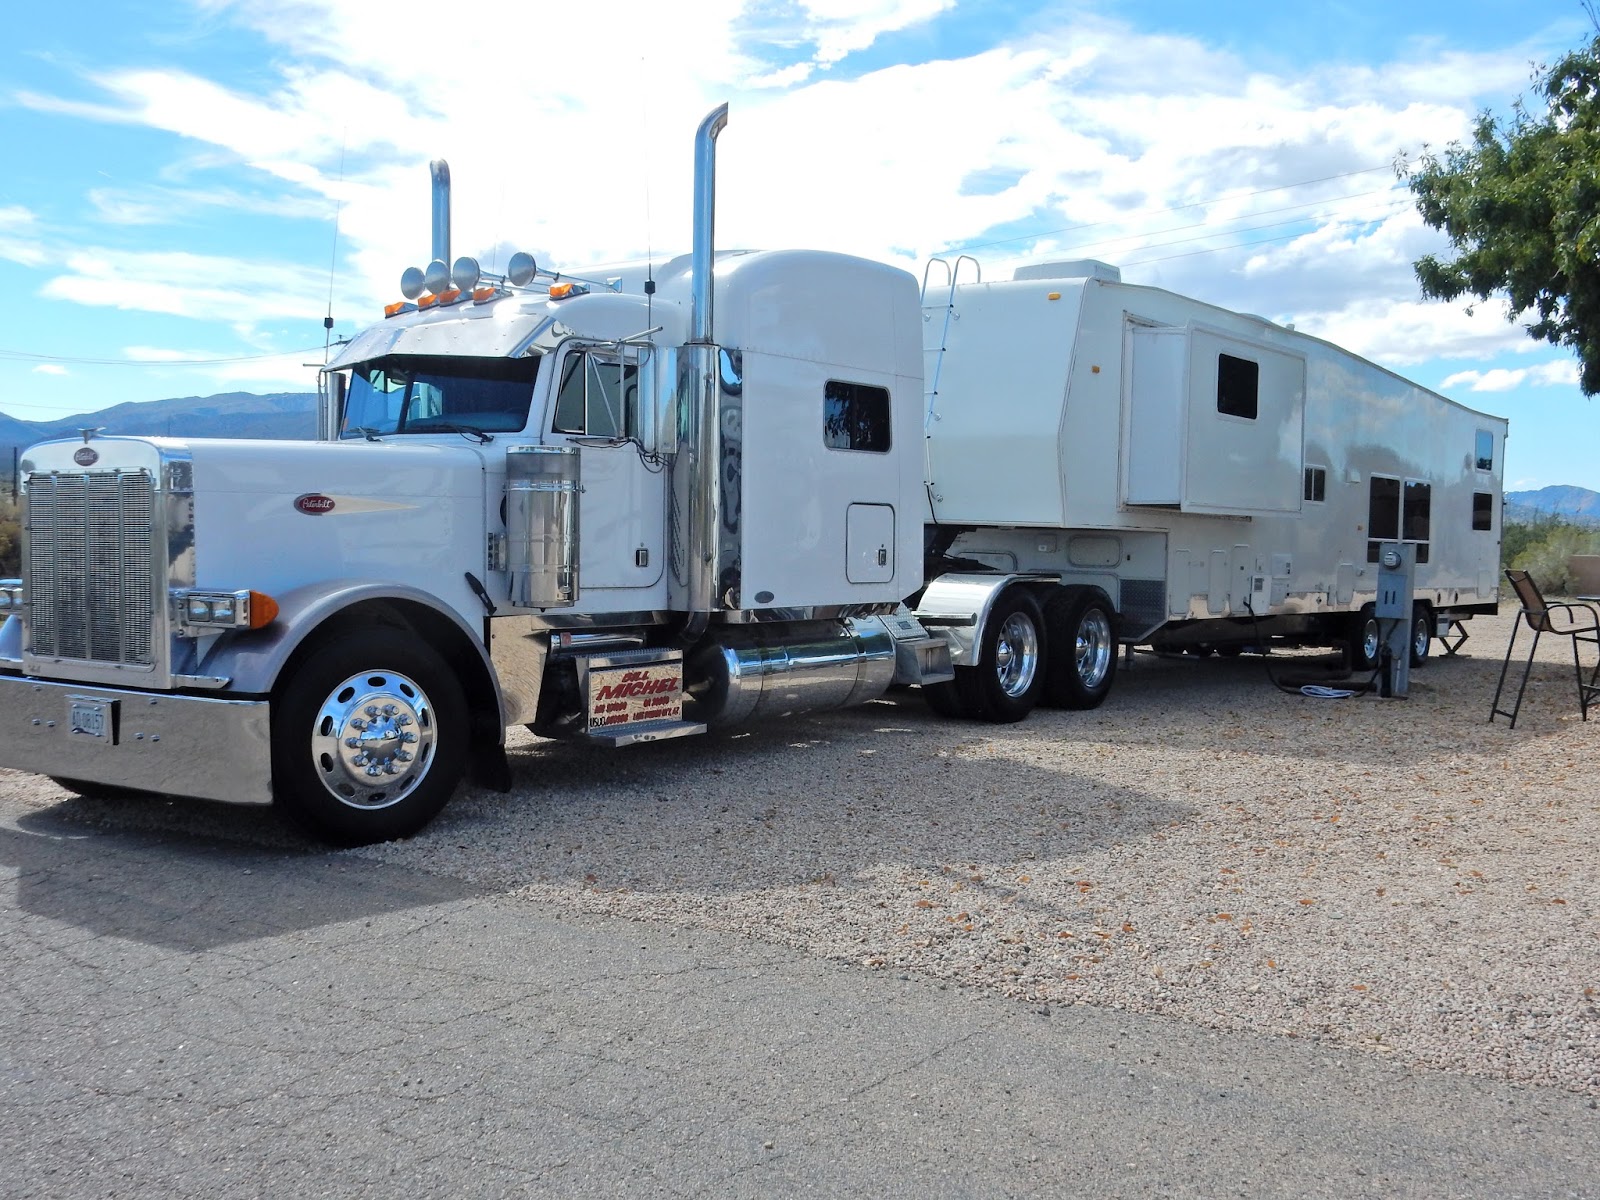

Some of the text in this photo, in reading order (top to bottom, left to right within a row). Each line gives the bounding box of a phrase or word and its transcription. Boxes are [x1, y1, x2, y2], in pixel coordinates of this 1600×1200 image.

[302, 498, 332, 509] Peterbilt
[622, 671, 649, 682] BILL
[596, 678, 678, 700] MICHEL
